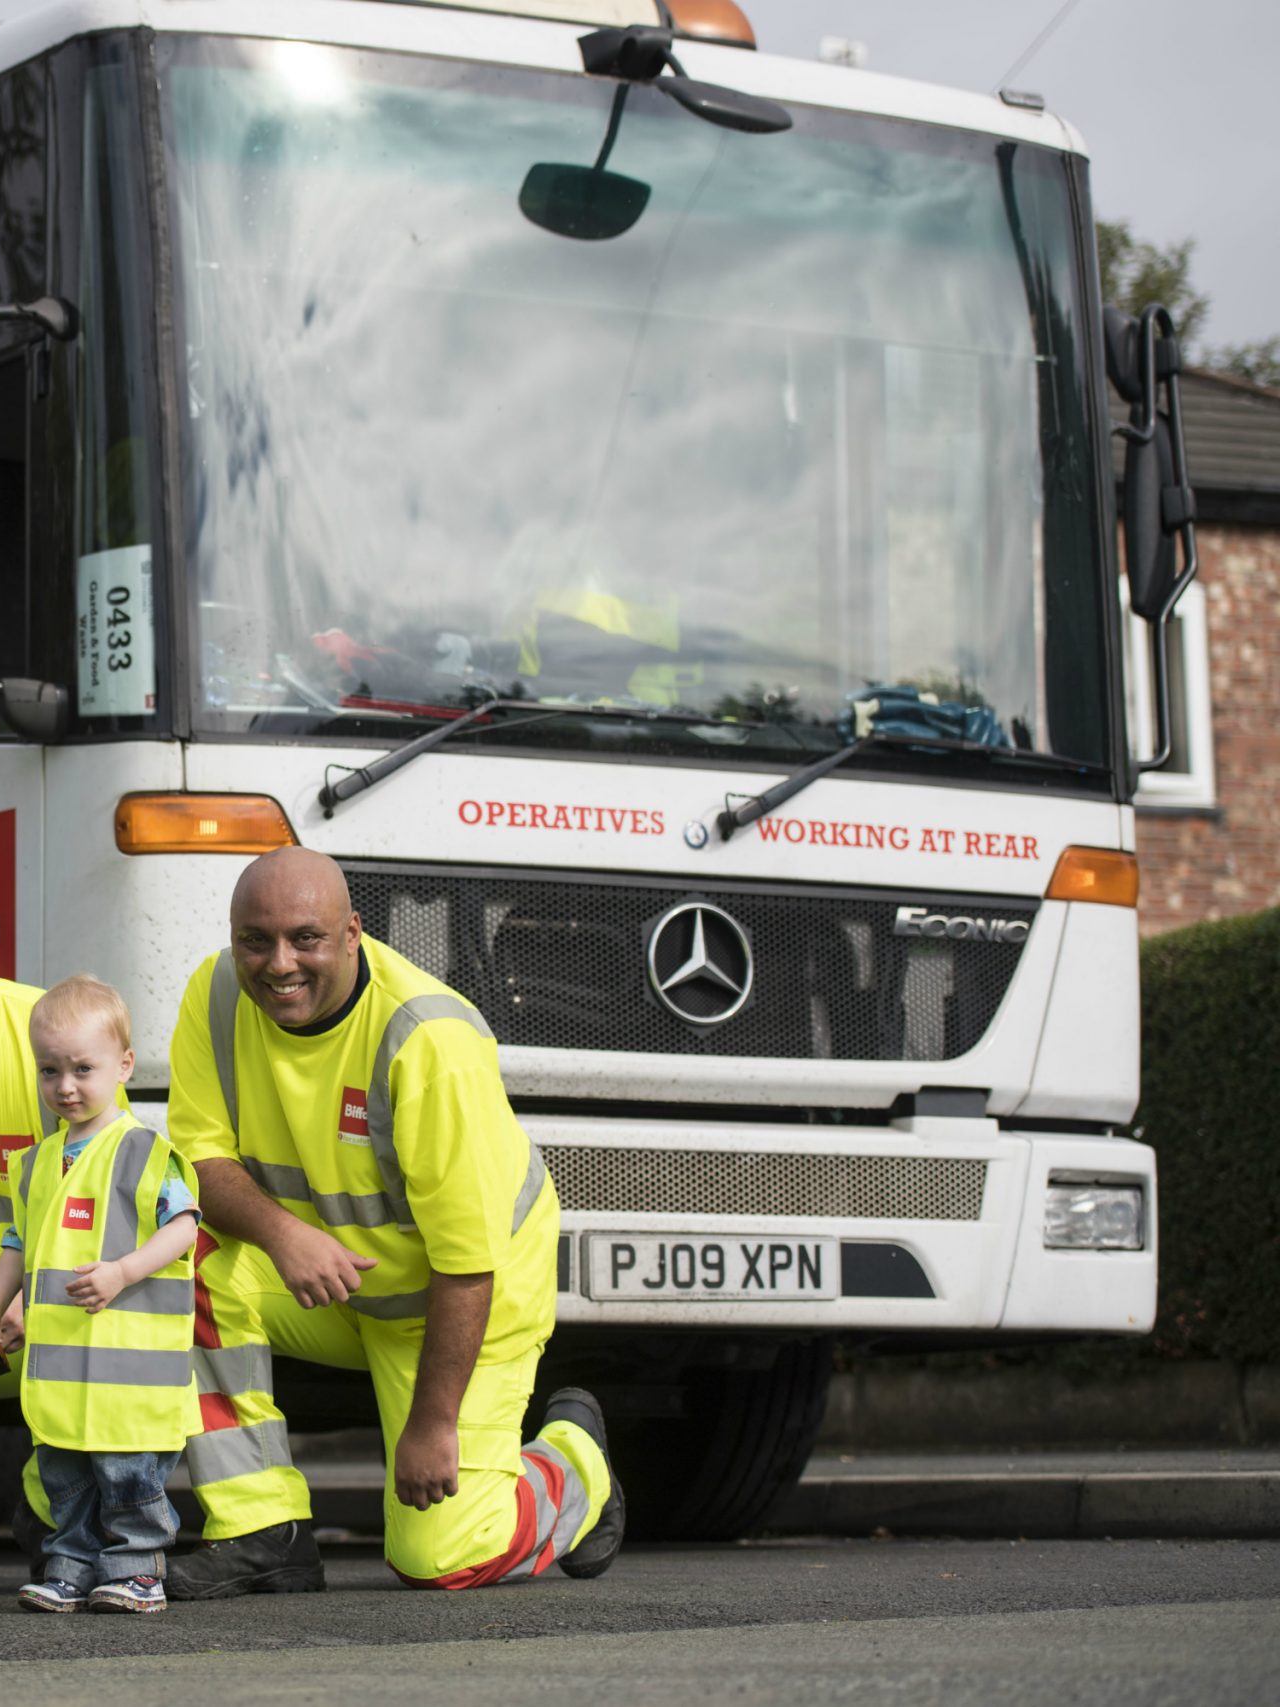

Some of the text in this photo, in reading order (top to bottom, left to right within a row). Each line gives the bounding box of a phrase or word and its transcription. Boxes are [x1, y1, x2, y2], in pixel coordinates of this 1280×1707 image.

[89, 581, 100, 687] Garden & Food
[106, 586, 132, 673] 0433
[458, 800, 1040, 860] OPERATIVES WORKING AT REAR
[68, 1208, 90, 1219] Biffa
[610, 1242, 821, 1289] PJ09 XPN
